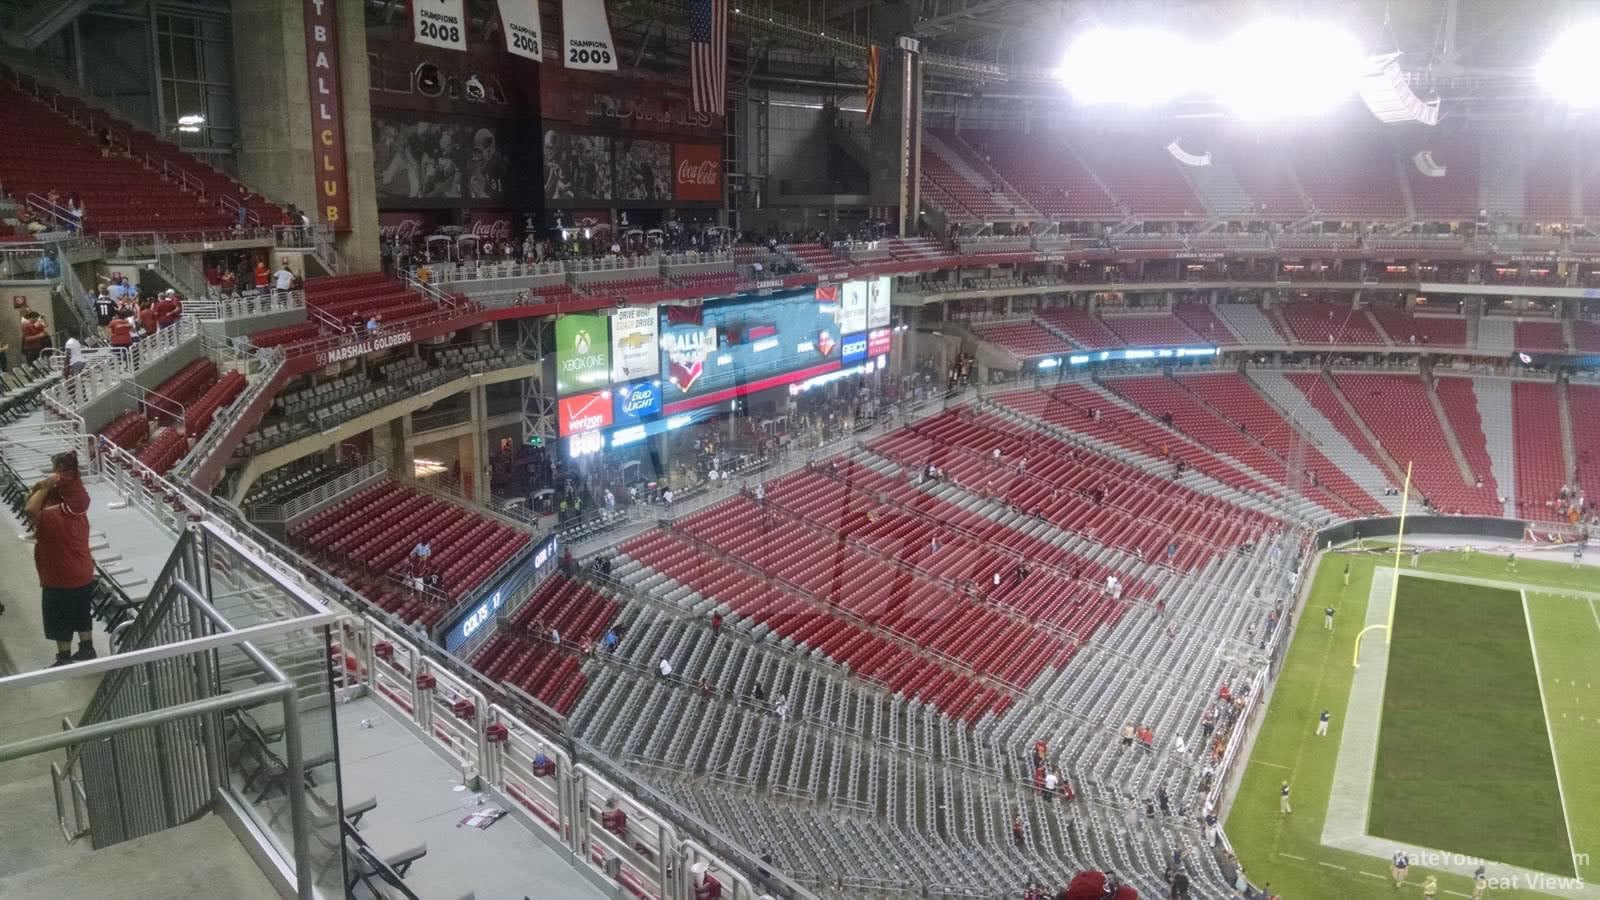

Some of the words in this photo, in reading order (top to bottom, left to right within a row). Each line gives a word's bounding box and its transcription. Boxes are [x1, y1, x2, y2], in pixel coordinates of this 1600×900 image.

[420, 9, 458, 24] CHAMPIONS
[420, 20, 460, 43] 2008
[569, 39, 608, 49] CHAMPIONS
[570, 48, 611, 64] 2009
[321, 129, 338, 221] CLUB
[756, 279, 784, 289] CARDINALS
[100, 304, 109, 316] 11
[619, 310, 635, 320] DRIVE
[316, 352, 327, 367] 99
[328, 341, 373, 362] MARSHALL
[373, 331, 412, 350] GOLDBERG
[562, 356, 586, 372] XBOX
[586, 354, 604, 368] ONE
[632, 390, 652, 401] BUD
[628, 397, 655, 411] LIGHT
[568, 414, 603, 431] verizon
[464, 604, 488, 637] COLTS
[493, 591, 501, 609] 17
